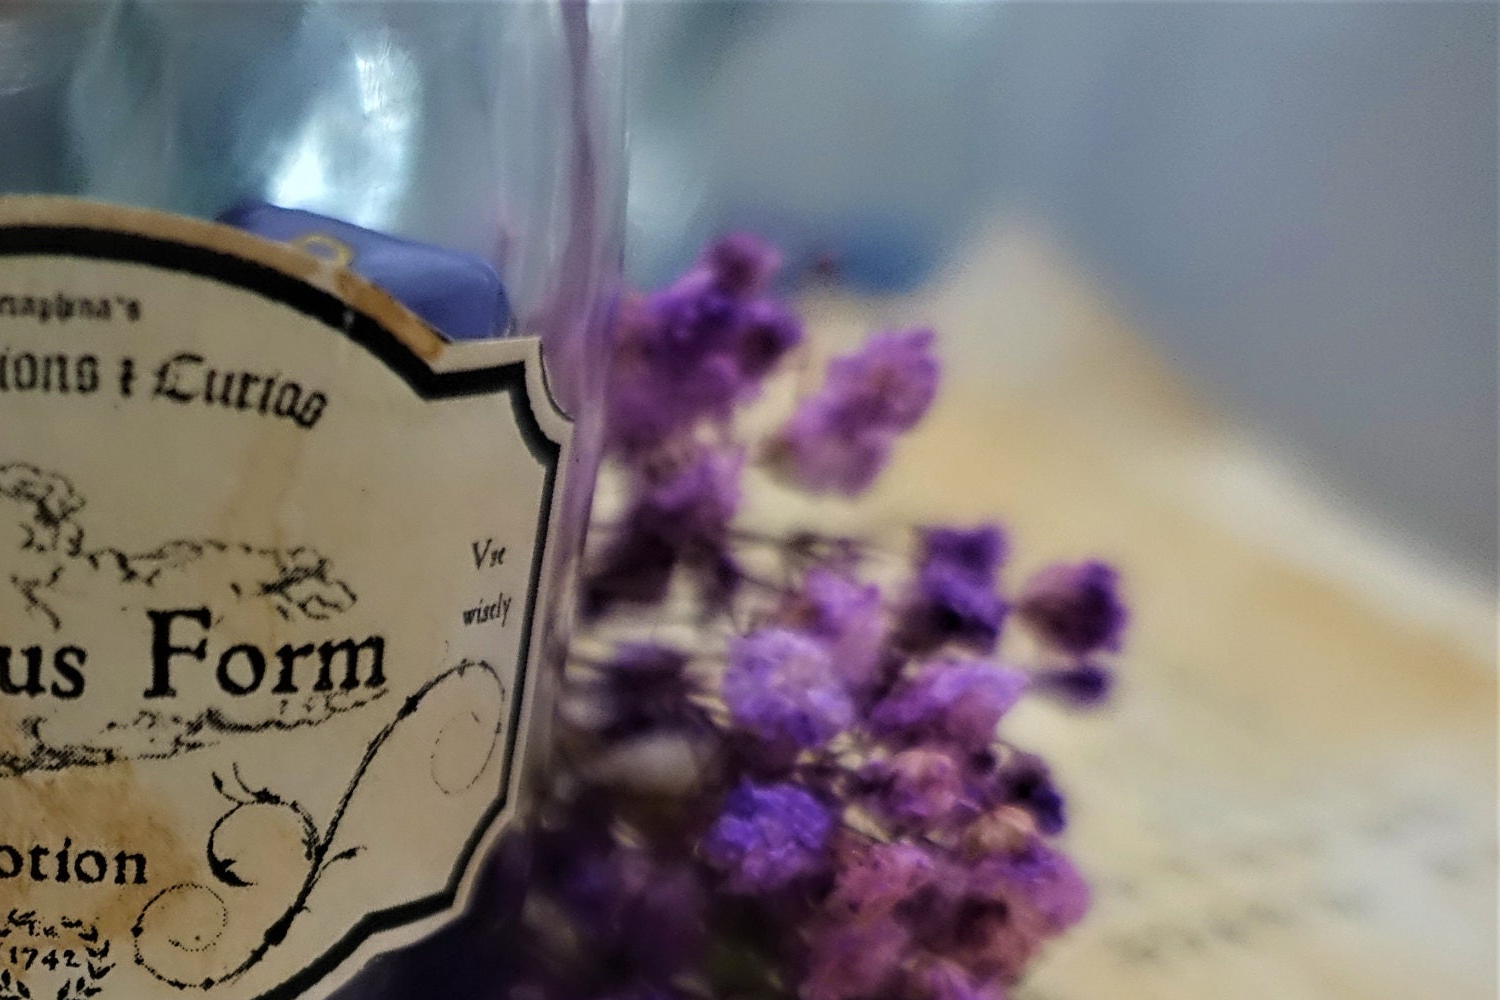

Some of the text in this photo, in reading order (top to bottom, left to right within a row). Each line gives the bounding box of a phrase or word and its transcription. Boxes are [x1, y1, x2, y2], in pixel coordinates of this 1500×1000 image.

[462, 591, 512, 628] wisely
[145, 606, 387, 699] Form
[8, 946, 81, 971] 1742
